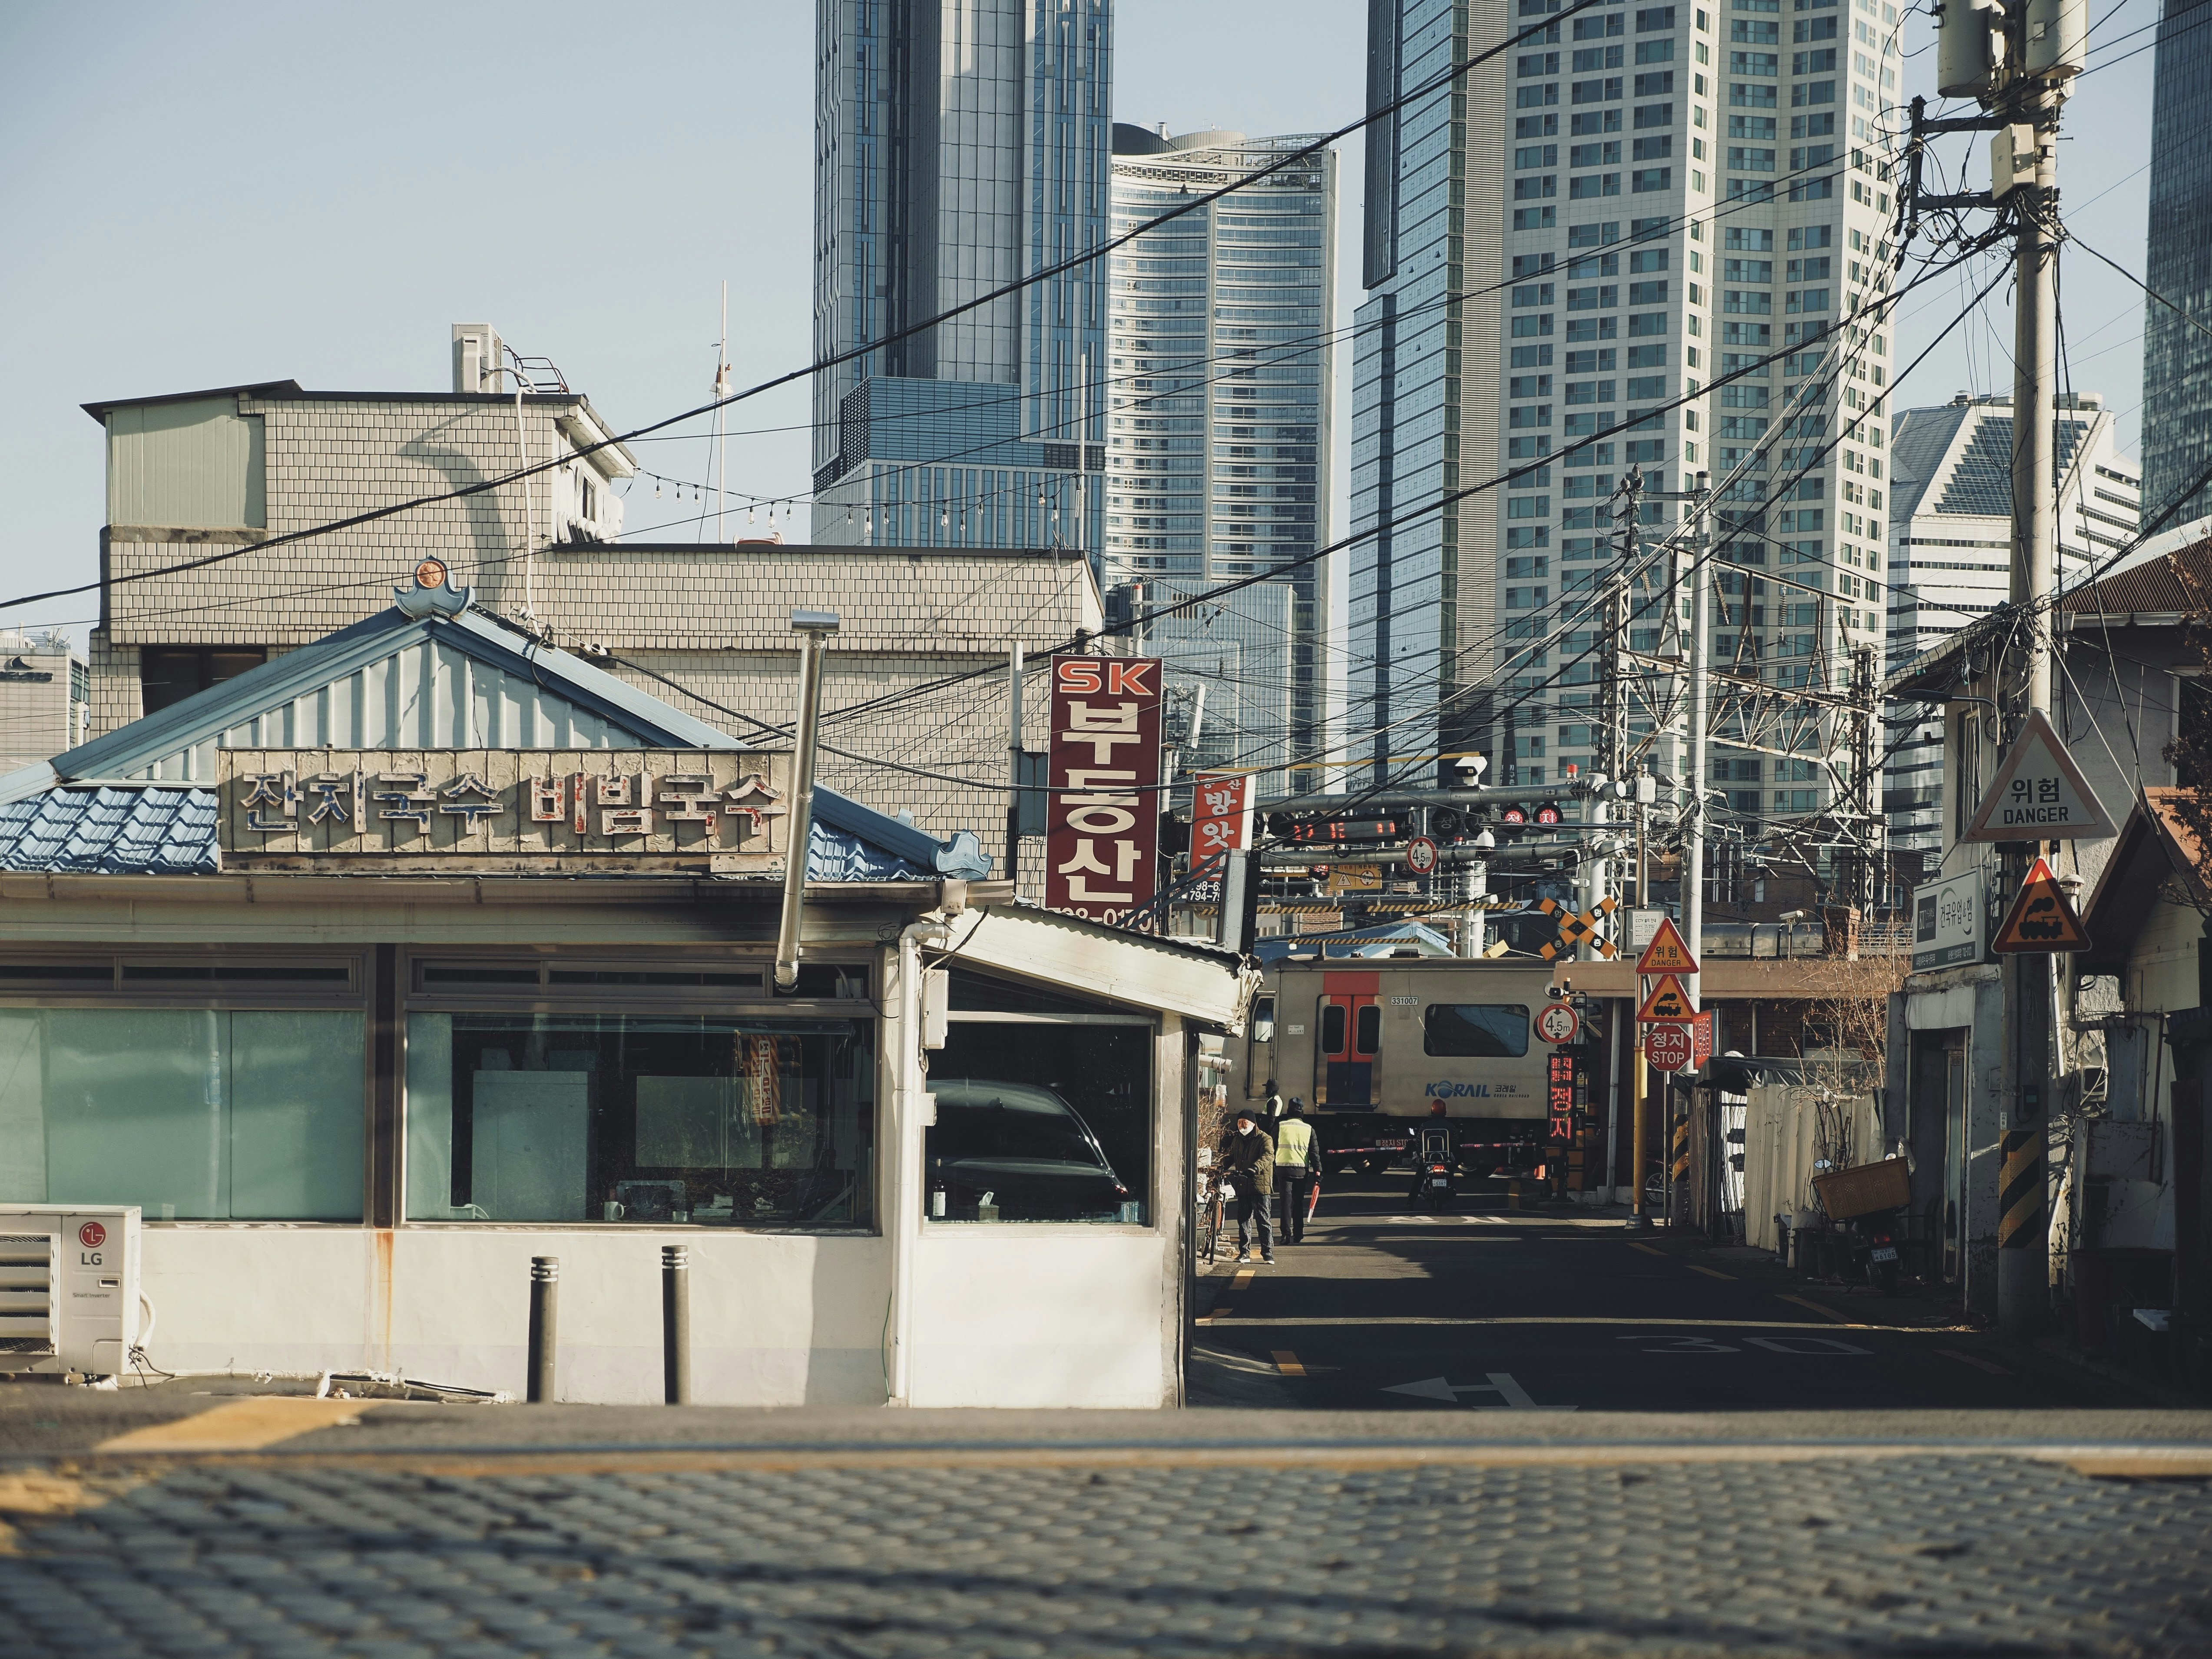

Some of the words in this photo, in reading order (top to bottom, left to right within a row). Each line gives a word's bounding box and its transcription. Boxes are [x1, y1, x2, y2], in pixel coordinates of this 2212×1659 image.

[1058, 661, 1156, 695] SK
[2011, 778, 2060, 804] 위험
[240, 770, 504, 835] 잔치국수
[530, 770, 787, 836] 비빔국수
[1058, 701, 1141, 902] 부동산
[2003, 806, 2069, 825] DANGER
[1413, 848, 1431, 863] 4.5m
[1192, 881, 1221, 891] 98-6
[1919, 910, 1926, 930] KU
[1655, 946, 1678, 959] 위험
[1545, 1019, 1570, 1032] 4.5m
[1652, 1032, 1685, 1049] 정지
[1652, 1052, 1685, 1064] STOP
[1425, 1080, 1490, 1098] KORAIL
[1495, 1085, 1517, 1093] 코레일
[81, 1252, 102, 1265] LG
[1615, 1336, 1875, 1355] 30
